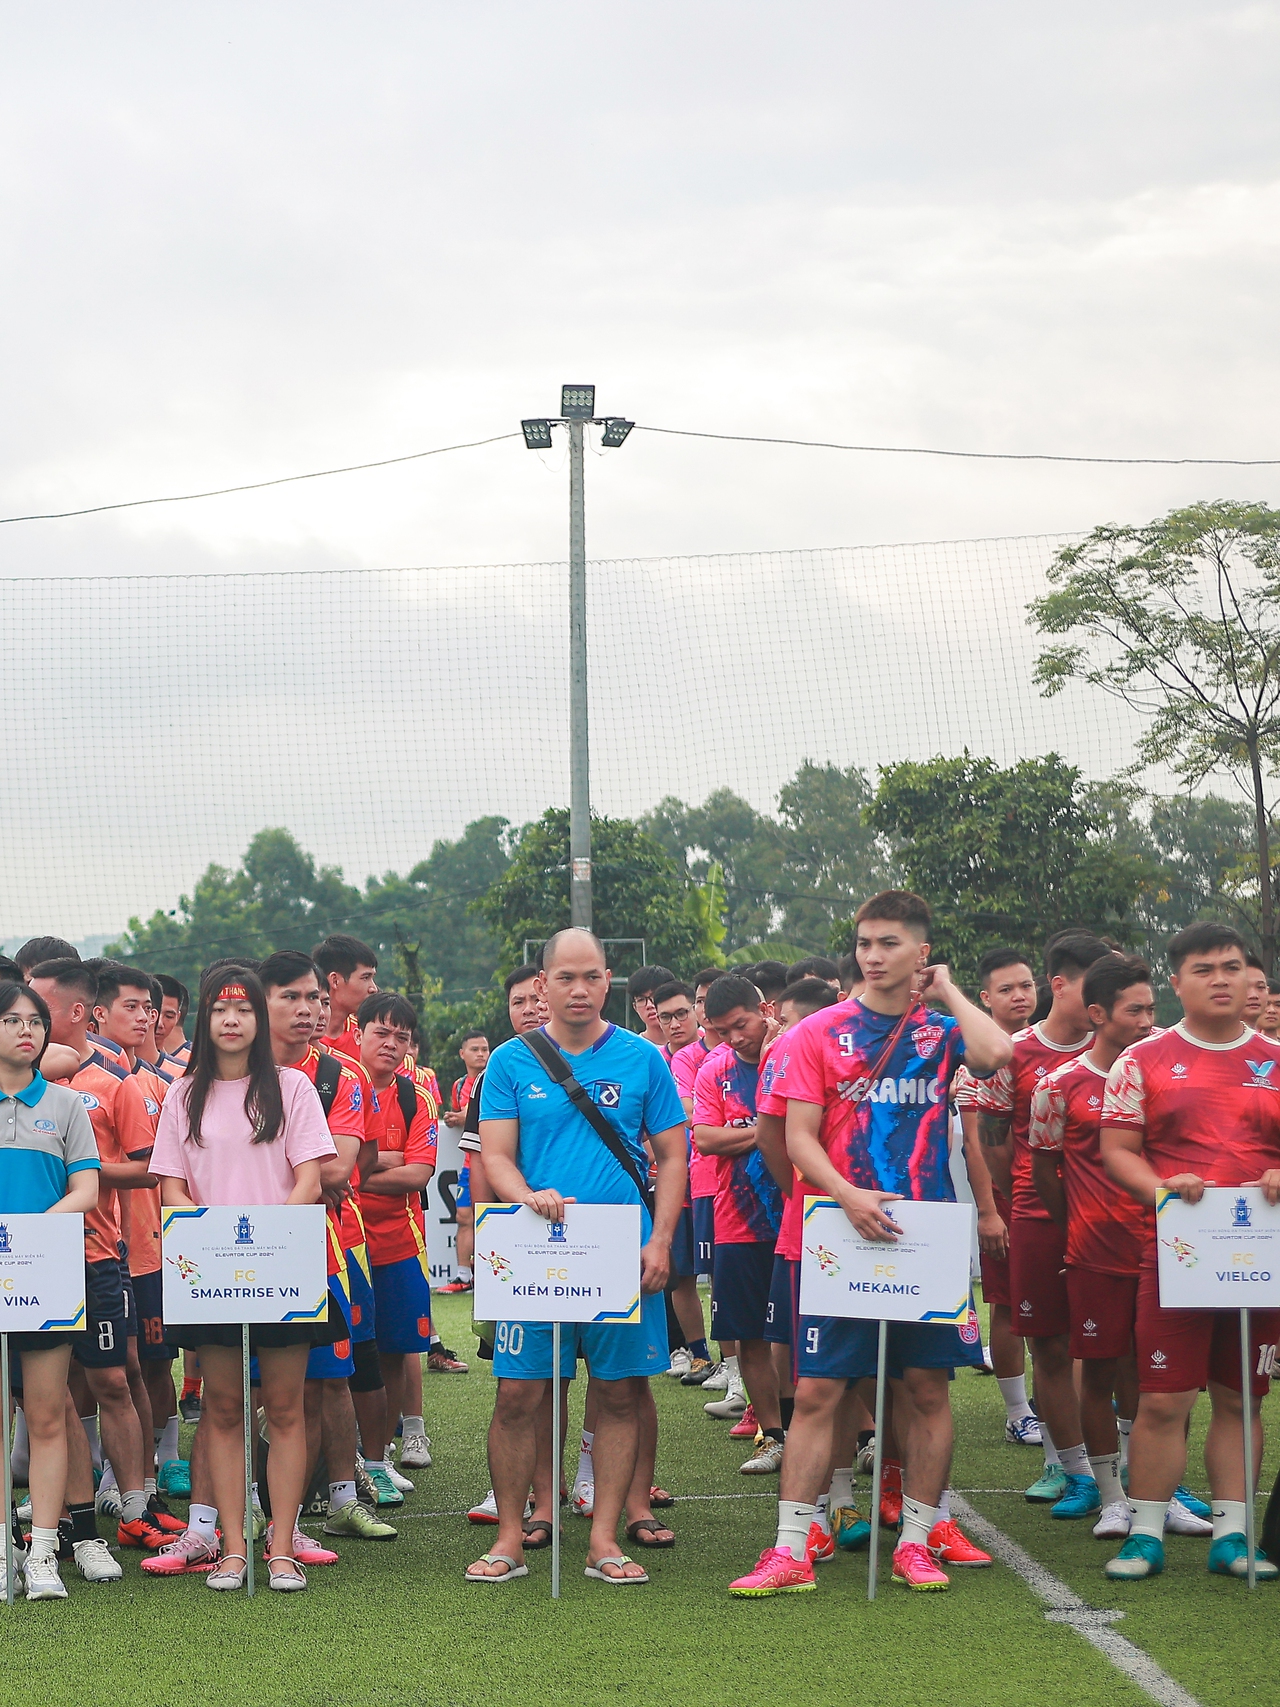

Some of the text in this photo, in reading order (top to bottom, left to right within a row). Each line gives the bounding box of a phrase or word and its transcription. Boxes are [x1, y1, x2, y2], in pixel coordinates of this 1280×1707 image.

[839, 1033, 853, 1056] 9
[837, 1077, 940, 1104] MEKAMIC
[699, 1242, 710, 1259] 11
[1232, 1253, 1254, 1265] FC
[235, 1270, 255, 1282] FC
[546, 1268, 568, 1280] FC
[874, 1265, 896, 1277] FC
[1216, 1272, 1271, 1282] VIELCO
[191, 1287, 299, 1298] SMARTRISE VN
[513, 1282, 602, 1299] KIỂM ĐỊNH 1
[849, 1282, 920, 1295] MEKAMIC
[4, 1296, 40, 1306] VINA
[766, 1302, 774, 1323] 3
[142, 1317, 163, 1344] 18
[497, 1322, 524, 1355] 90
[806, 1328, 818, 1354] 9
[1257, 1344, 1276, 1375] 10
